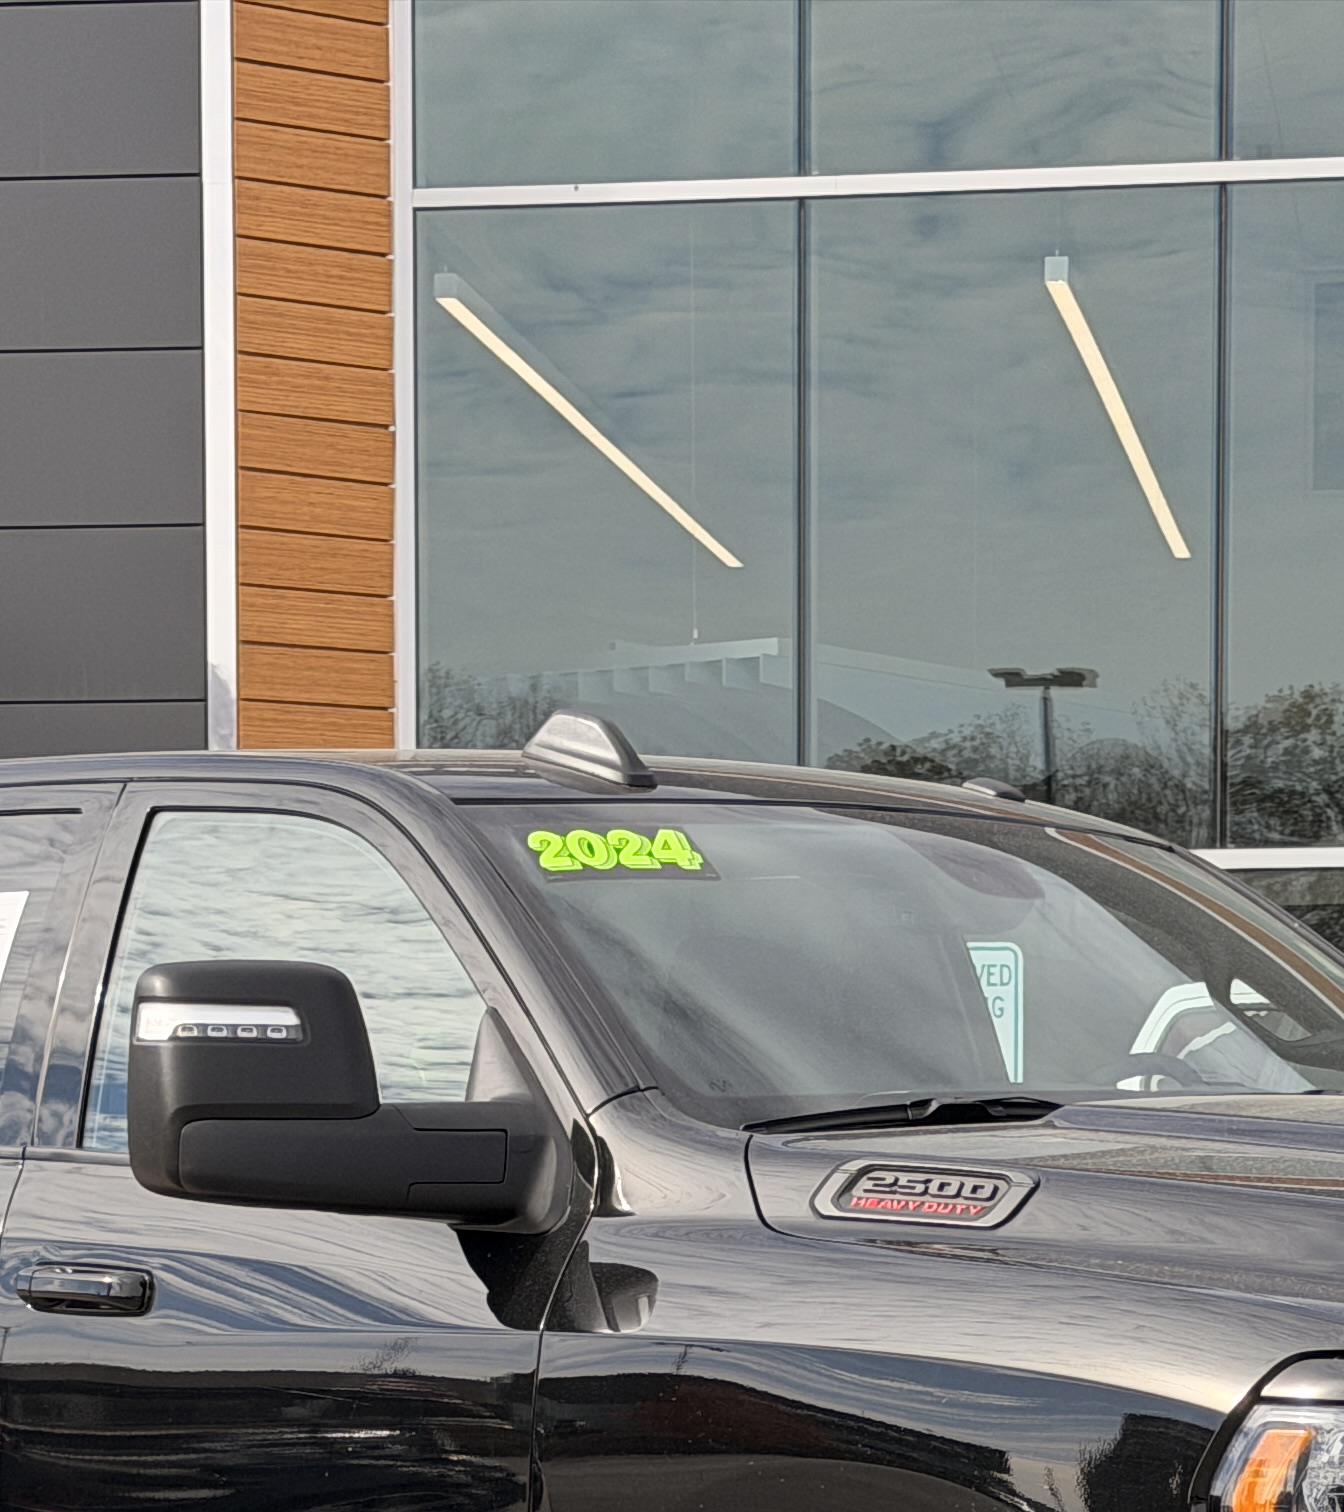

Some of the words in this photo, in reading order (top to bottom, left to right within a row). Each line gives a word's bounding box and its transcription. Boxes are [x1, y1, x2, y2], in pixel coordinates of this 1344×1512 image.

[527, 828, 704, 871] 2024
[862, 1173, 999, 1202] 2500
[850, 1196, 922, 1212] HEAVY
[922, 1201, 986, 1216] DUTY
